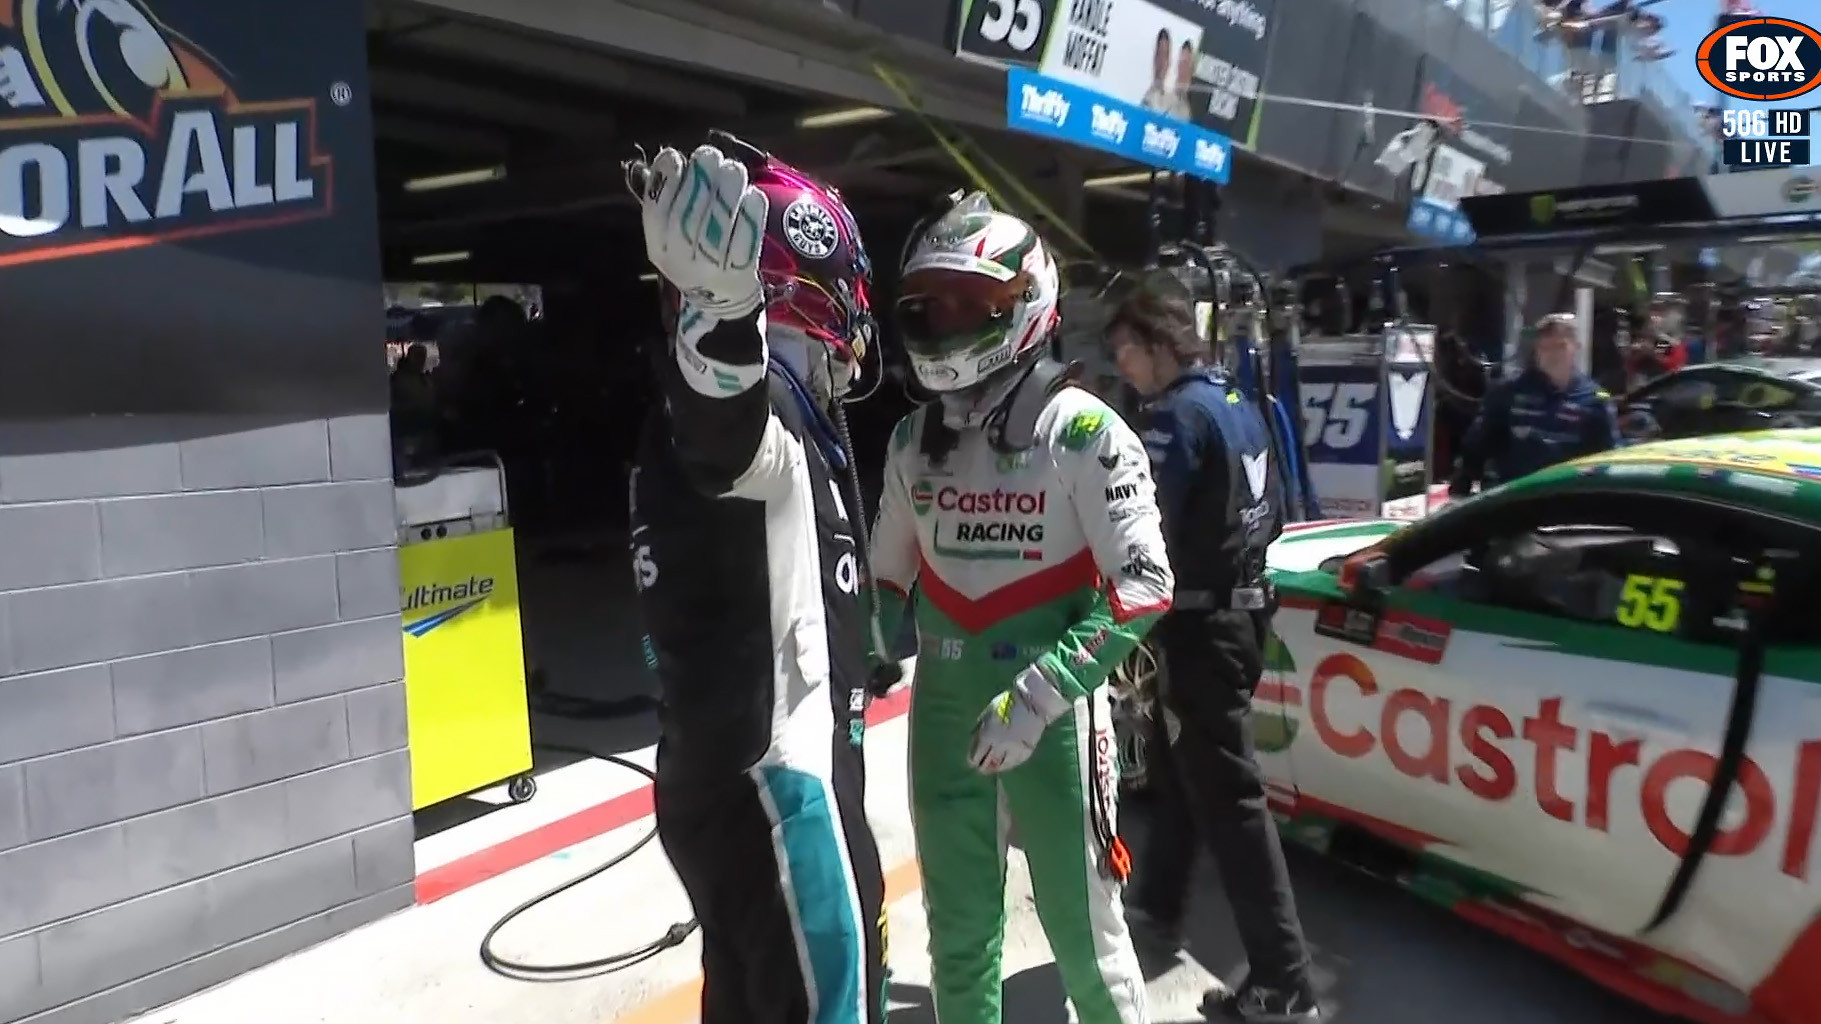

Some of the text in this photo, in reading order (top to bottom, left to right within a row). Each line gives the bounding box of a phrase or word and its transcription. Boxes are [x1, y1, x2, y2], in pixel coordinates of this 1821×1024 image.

[1299, 382, 1378, 449] 55
[937, 486, 1046, 515] Castrol
[1105, 483, 1138, 503] NAVY
[957, 522, 1044, 542] RACING
[1616, 573, 1686, 633] 55
[1309, 653, 1821, 882] Castrol
